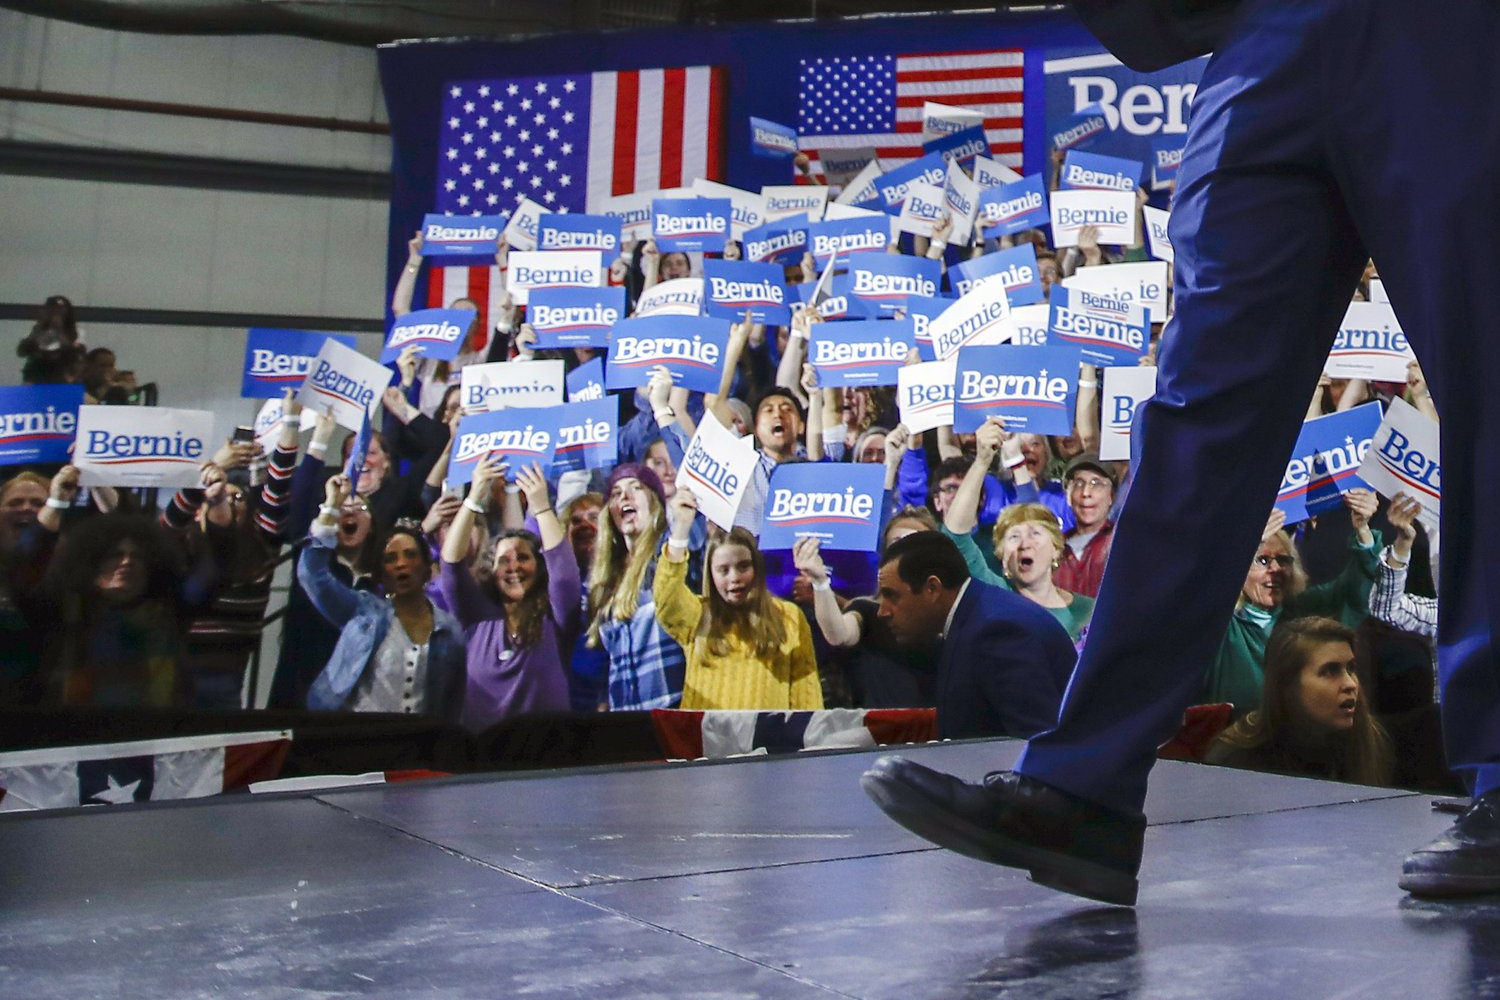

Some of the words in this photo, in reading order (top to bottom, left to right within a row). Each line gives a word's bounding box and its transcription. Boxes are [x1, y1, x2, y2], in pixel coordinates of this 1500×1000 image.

[1068, 76, 1198, 136] Ber
[1053, 115, 1105, 148] Bernie
[1068, 164, 1135, 191] Bernie
[606, 205, 650, 225] erni
[731, 206, 757, 225] nie
[909, 197, 942, 219] Ber
[984, 190, 1043, 218] Bernie
[1057, 207, 1129, 225] Bernie
[425, 221, 498, 241] Bernie
[656, 213, 726, 232] Bernie
[541, 228, 616, 250] Bernie
[747, 228, 806, 260] Bernie
[814, 229, 886, 252] Bernie
[516, 262, 593, 284] Bernie
[854, 270, 936, 297] Bernie
[710, 277, 784, 302] Bernie
[533, 303, 618, 325] Bernie
[937, 298, 1001, 354] Bernie
[1055, 306, 1143, 349] Bernie
[390, 321, 461, 345] Bernie
[1332, 325, 1409, 351] ernie
[250, 349, 311, 373] Bern
[614, 335, 719, 364] Bernie
[815, 337, 908, 361] Bernie
[312, 359, 375, 408] Bernie
[907, 384, 954, 407] Ber
[961, 369, 1069, 401] Bernie
[0, 405, 75, 434] rnie
[555, 418, 610, 448] nie
[86, 430, 203, 458] Bernie
[457, 425, 549, 457] Bernie
[687, 436, 738, 497] Bernie
[1280, 436, 1373, 489] ernie
[1380, 427, 1440, 489] Ber
[769, 486, 873, 517] Bernie
